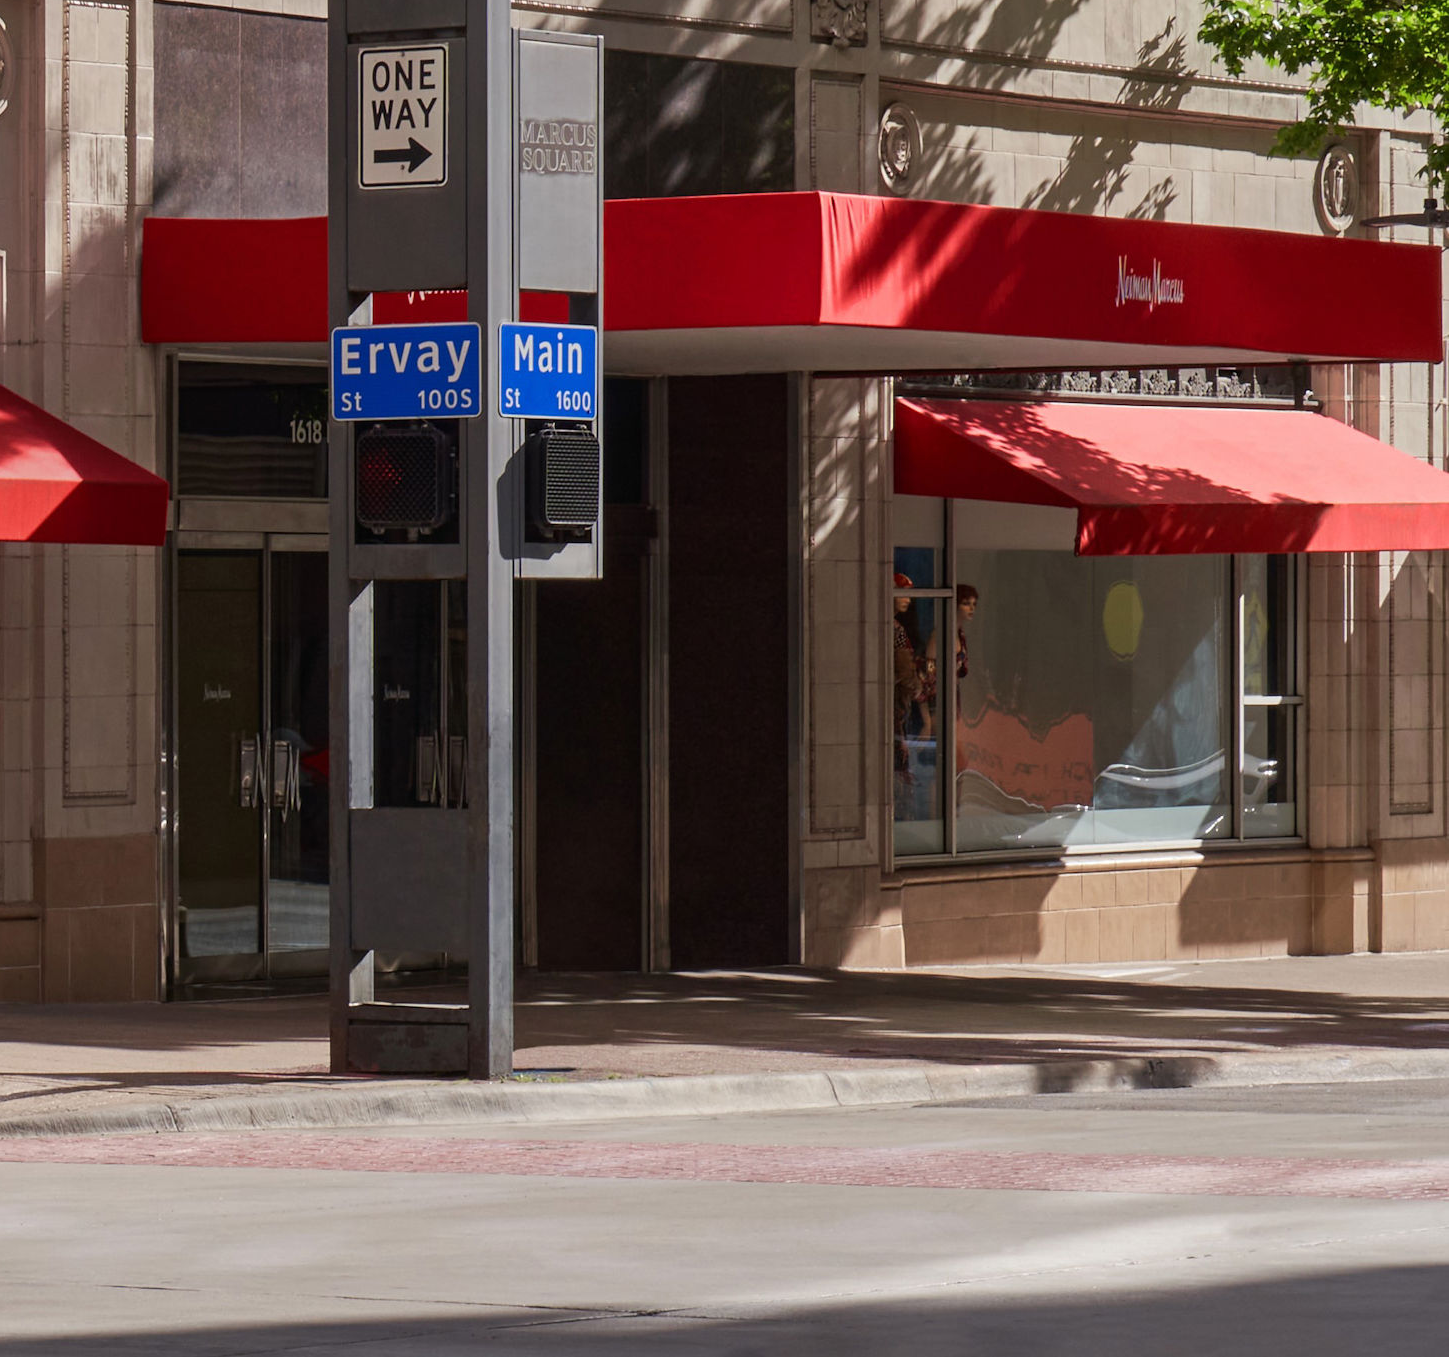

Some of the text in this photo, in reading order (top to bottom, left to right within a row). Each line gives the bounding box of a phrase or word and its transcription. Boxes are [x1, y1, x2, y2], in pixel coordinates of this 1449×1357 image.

[372, 60, 436, 92] ONE
[371, 97, 437, 130] WAY
[520, 121, 597, 147] MARCUS
[522, 147, 595, 174] SQUARE
[1115, 254, 1184, 313] Neiman Marcus
[341, 336, 471, 382] Ervay
[514, 333, 583, 374] Main
[341, 388, 473, 412] St 100S
[505, 387, 592, 413] St 1600
[290, 419, 322, 444] 1618
